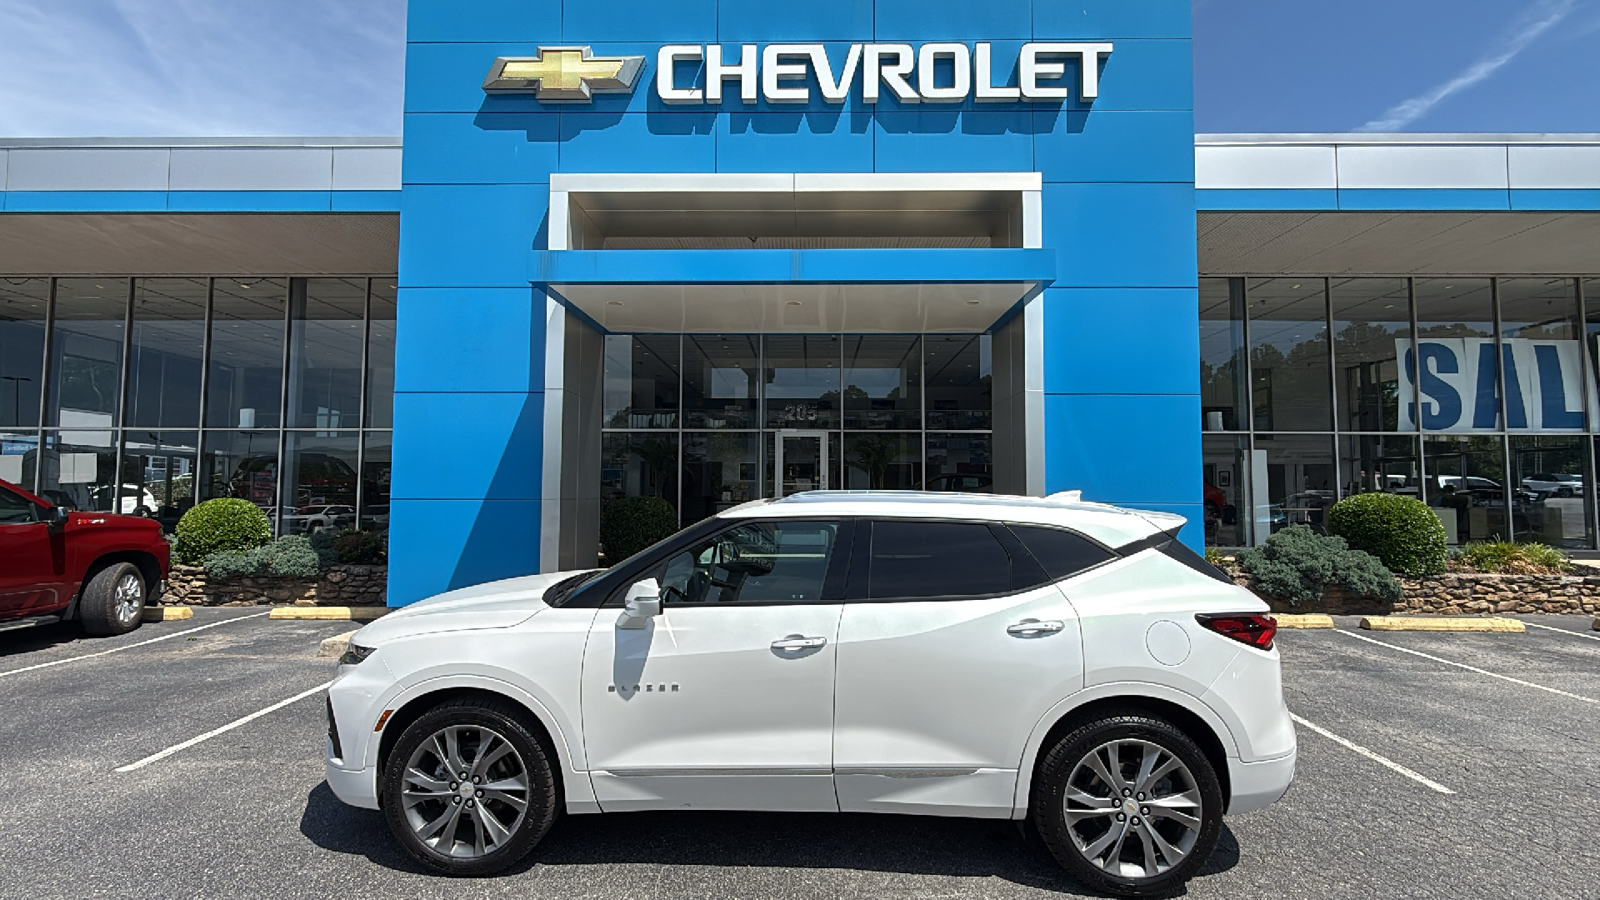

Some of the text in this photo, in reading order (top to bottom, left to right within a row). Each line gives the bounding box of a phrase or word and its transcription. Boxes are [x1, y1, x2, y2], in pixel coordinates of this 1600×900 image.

[656, 42, 1114, 104] CHEVROLET
[785, 404, 818, 420] 205
[607, 684, 679, 692] BLAZER
